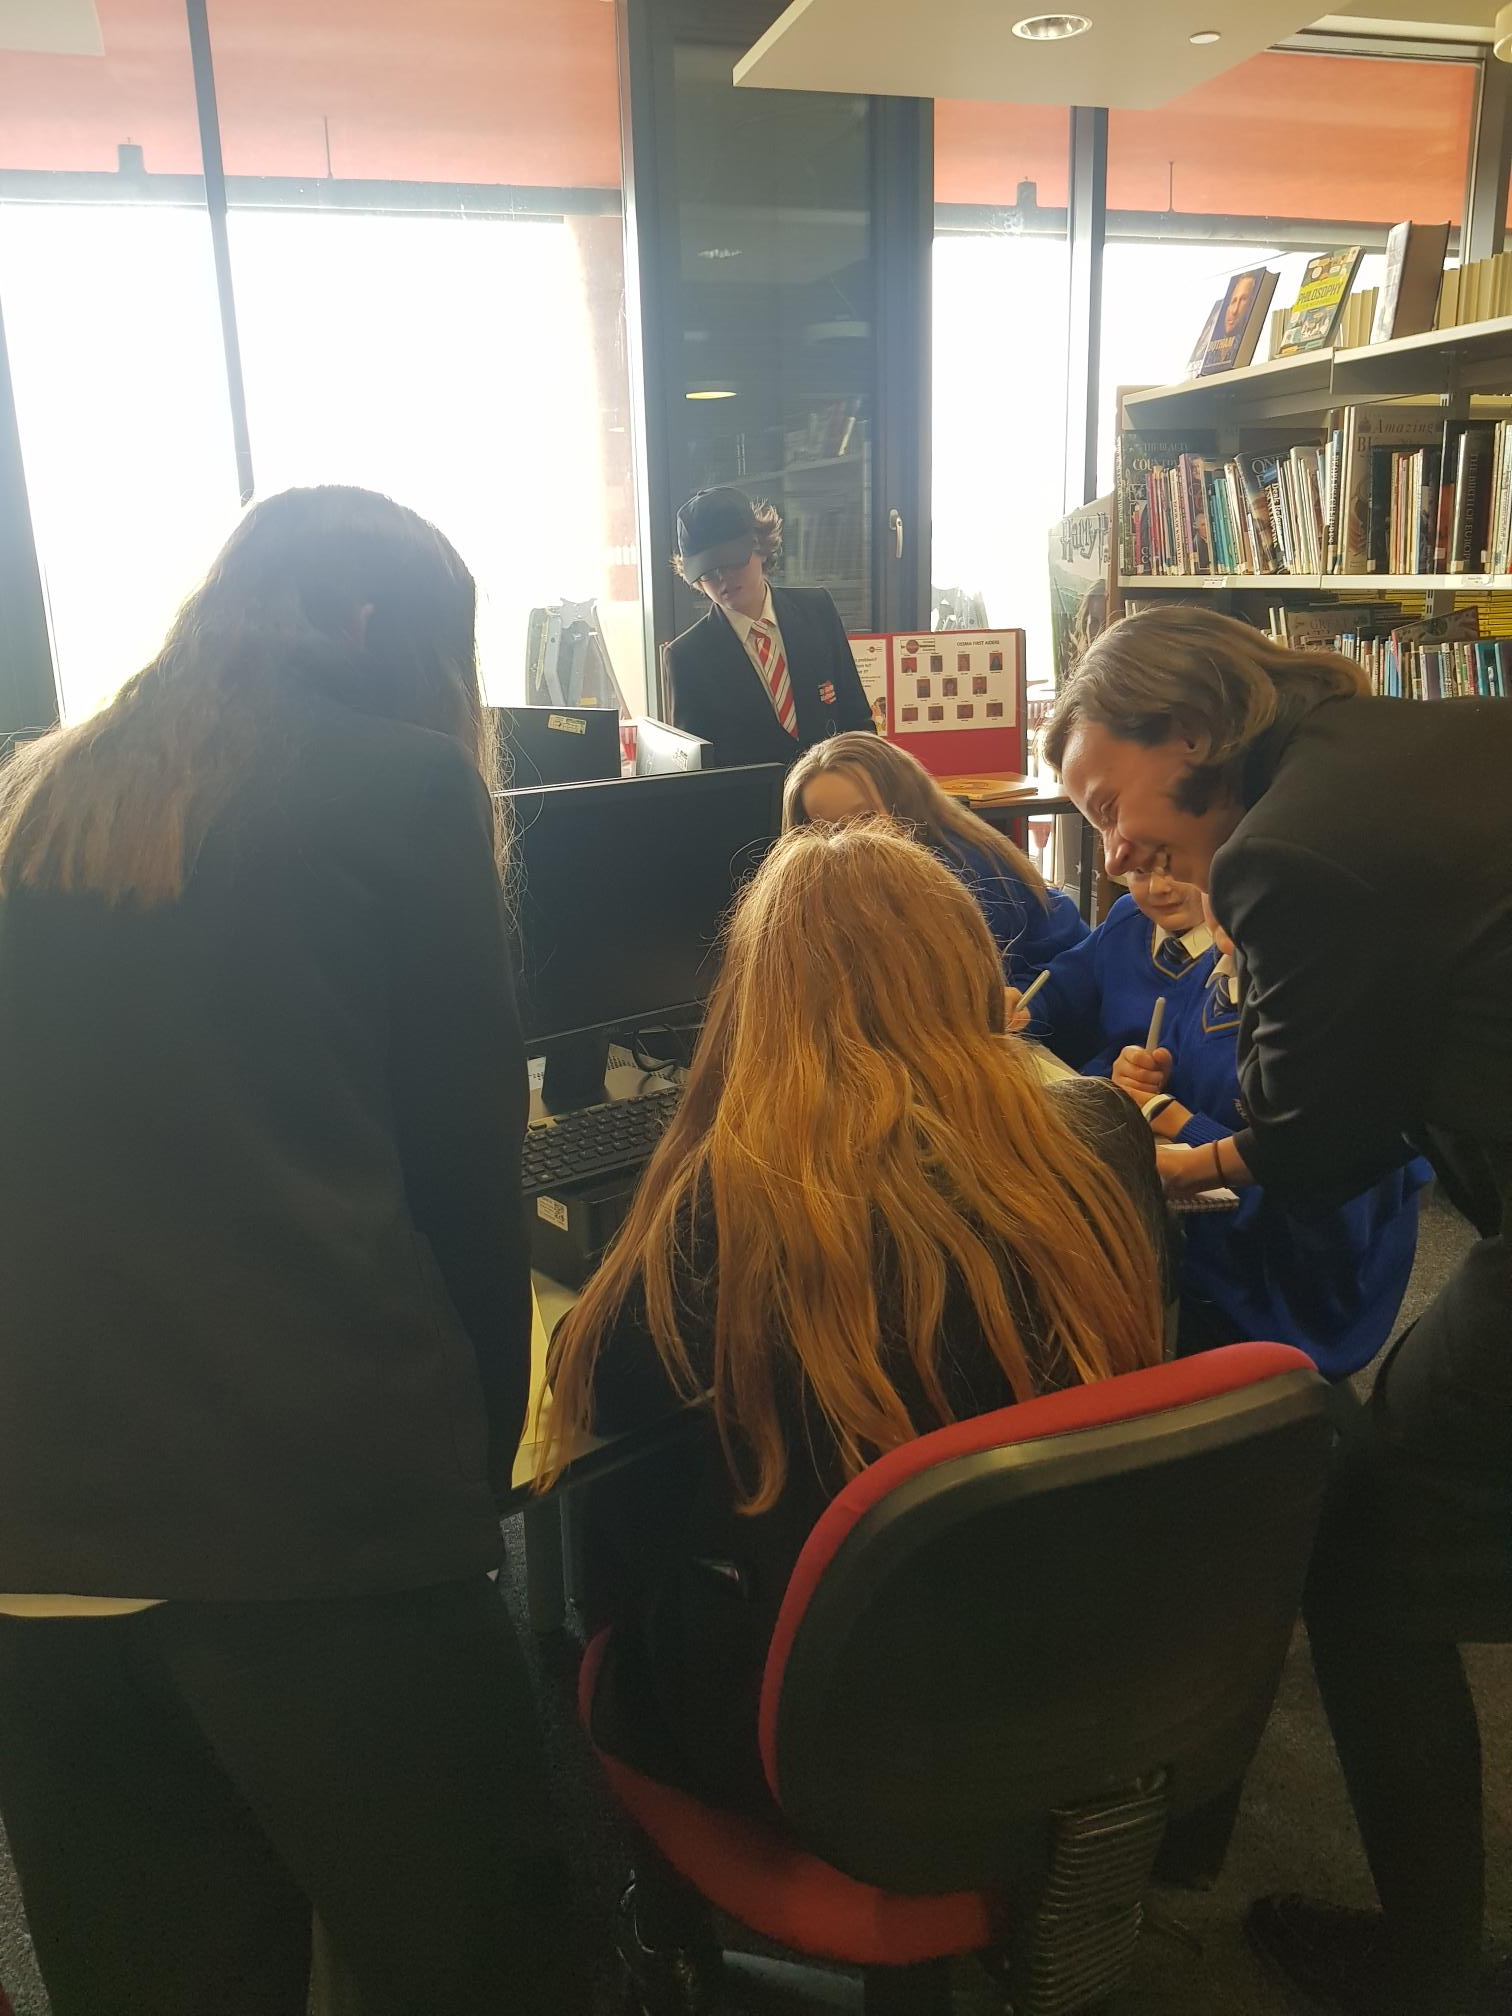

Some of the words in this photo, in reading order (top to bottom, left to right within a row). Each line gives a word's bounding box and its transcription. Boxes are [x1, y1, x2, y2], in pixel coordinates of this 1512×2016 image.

[1299, 282, 1343, 304] PHILOSOPHY
[1375, 417, 1434, 434] Amazing
[1463, 524, 1473, 561] EUROP
